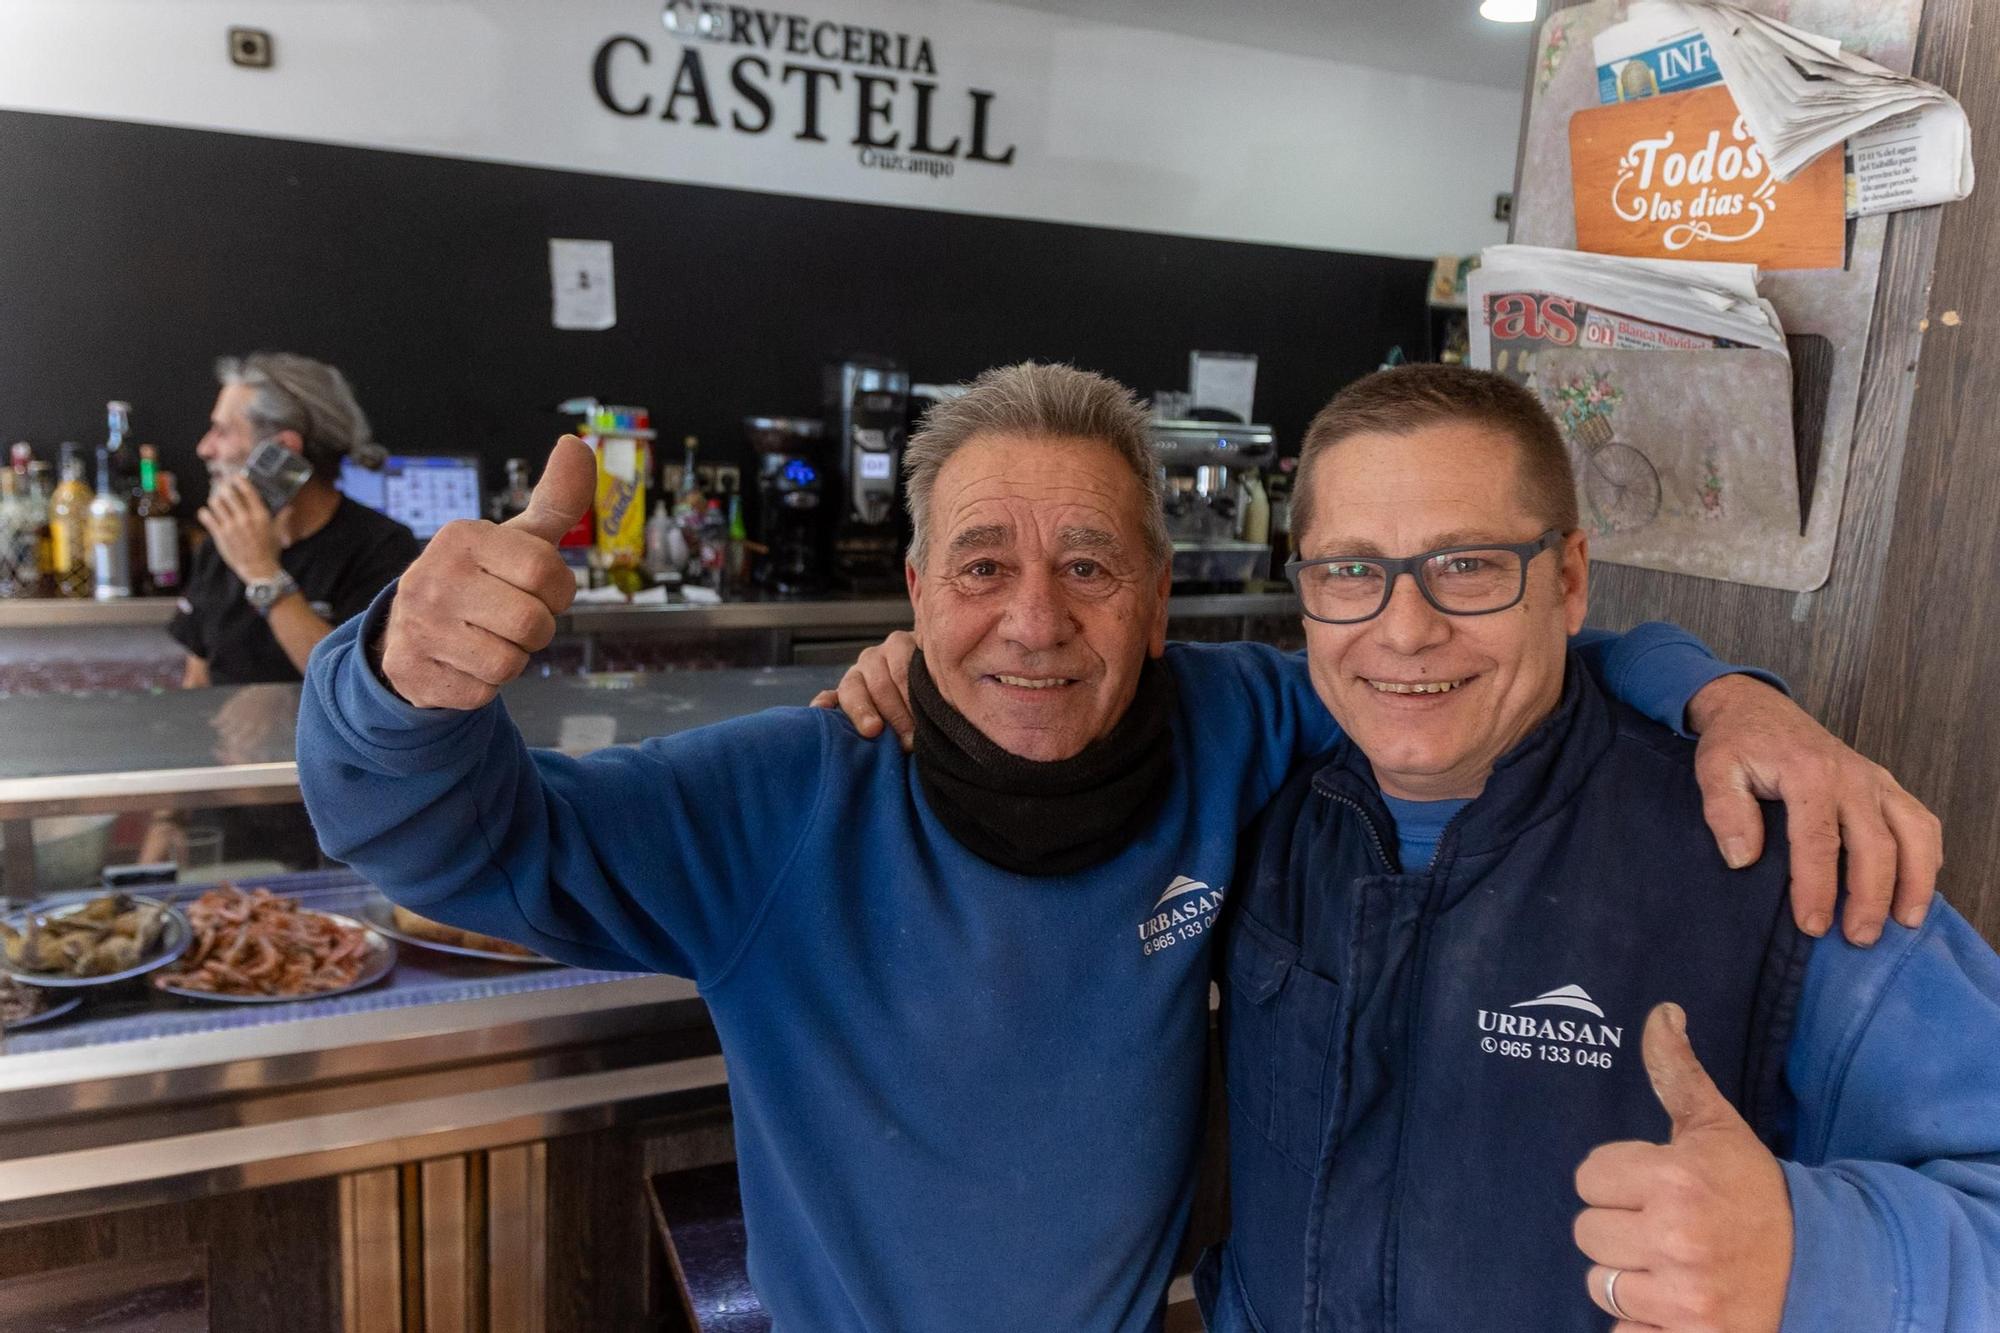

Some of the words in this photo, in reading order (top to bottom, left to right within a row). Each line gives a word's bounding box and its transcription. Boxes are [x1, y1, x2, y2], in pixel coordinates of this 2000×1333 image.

[592, 35, 1016, 166] CASTELL
[1628, 129, 1763, 190] Todos
[1650, 192, 1683, 221] los
[1491, 293, 1578, 346] as
[1618, 319, 1656, 341] Blanca
[1138, 887, 1224, 940] URBASAN
[1152, 932, 1176, 951] 965
[1178, 920, 1203, 940] 133
[1477, 1009, 1624, 1048] URBASAN
[1500, 1039, 1532, 1059] 965
[1538, 1044, 1571, 1063] 133
[1575, 1049, 1613, 1069] 046
